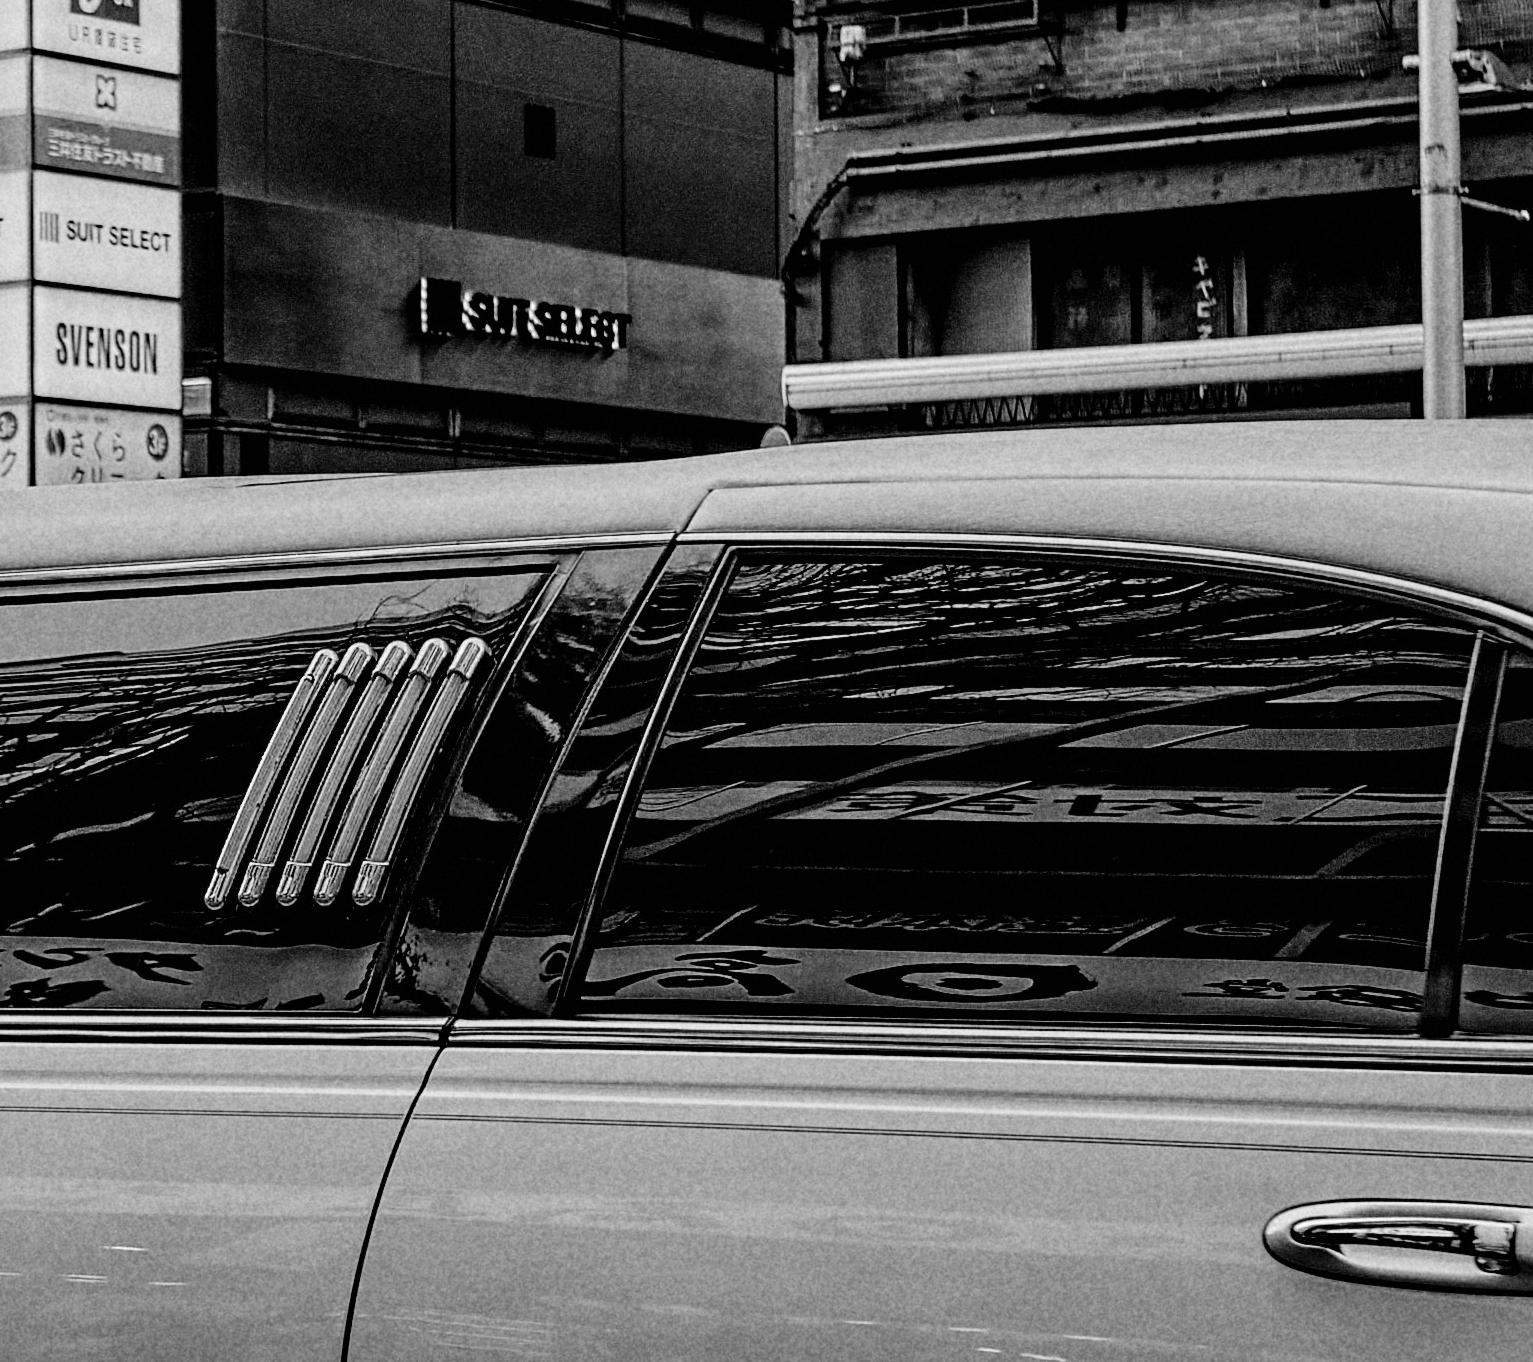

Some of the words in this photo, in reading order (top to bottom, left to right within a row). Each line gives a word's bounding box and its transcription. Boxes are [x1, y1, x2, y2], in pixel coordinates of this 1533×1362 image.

[65, 219, 103, 245] SUIT
[108, 225, 172, 253] SELECT
[462, 290, 531, 337] SUIT
[528, 300, 632, 351] SELECT
[55, 321, 159, 375] SVENSON
[71, 430, 126, 462] さくら
